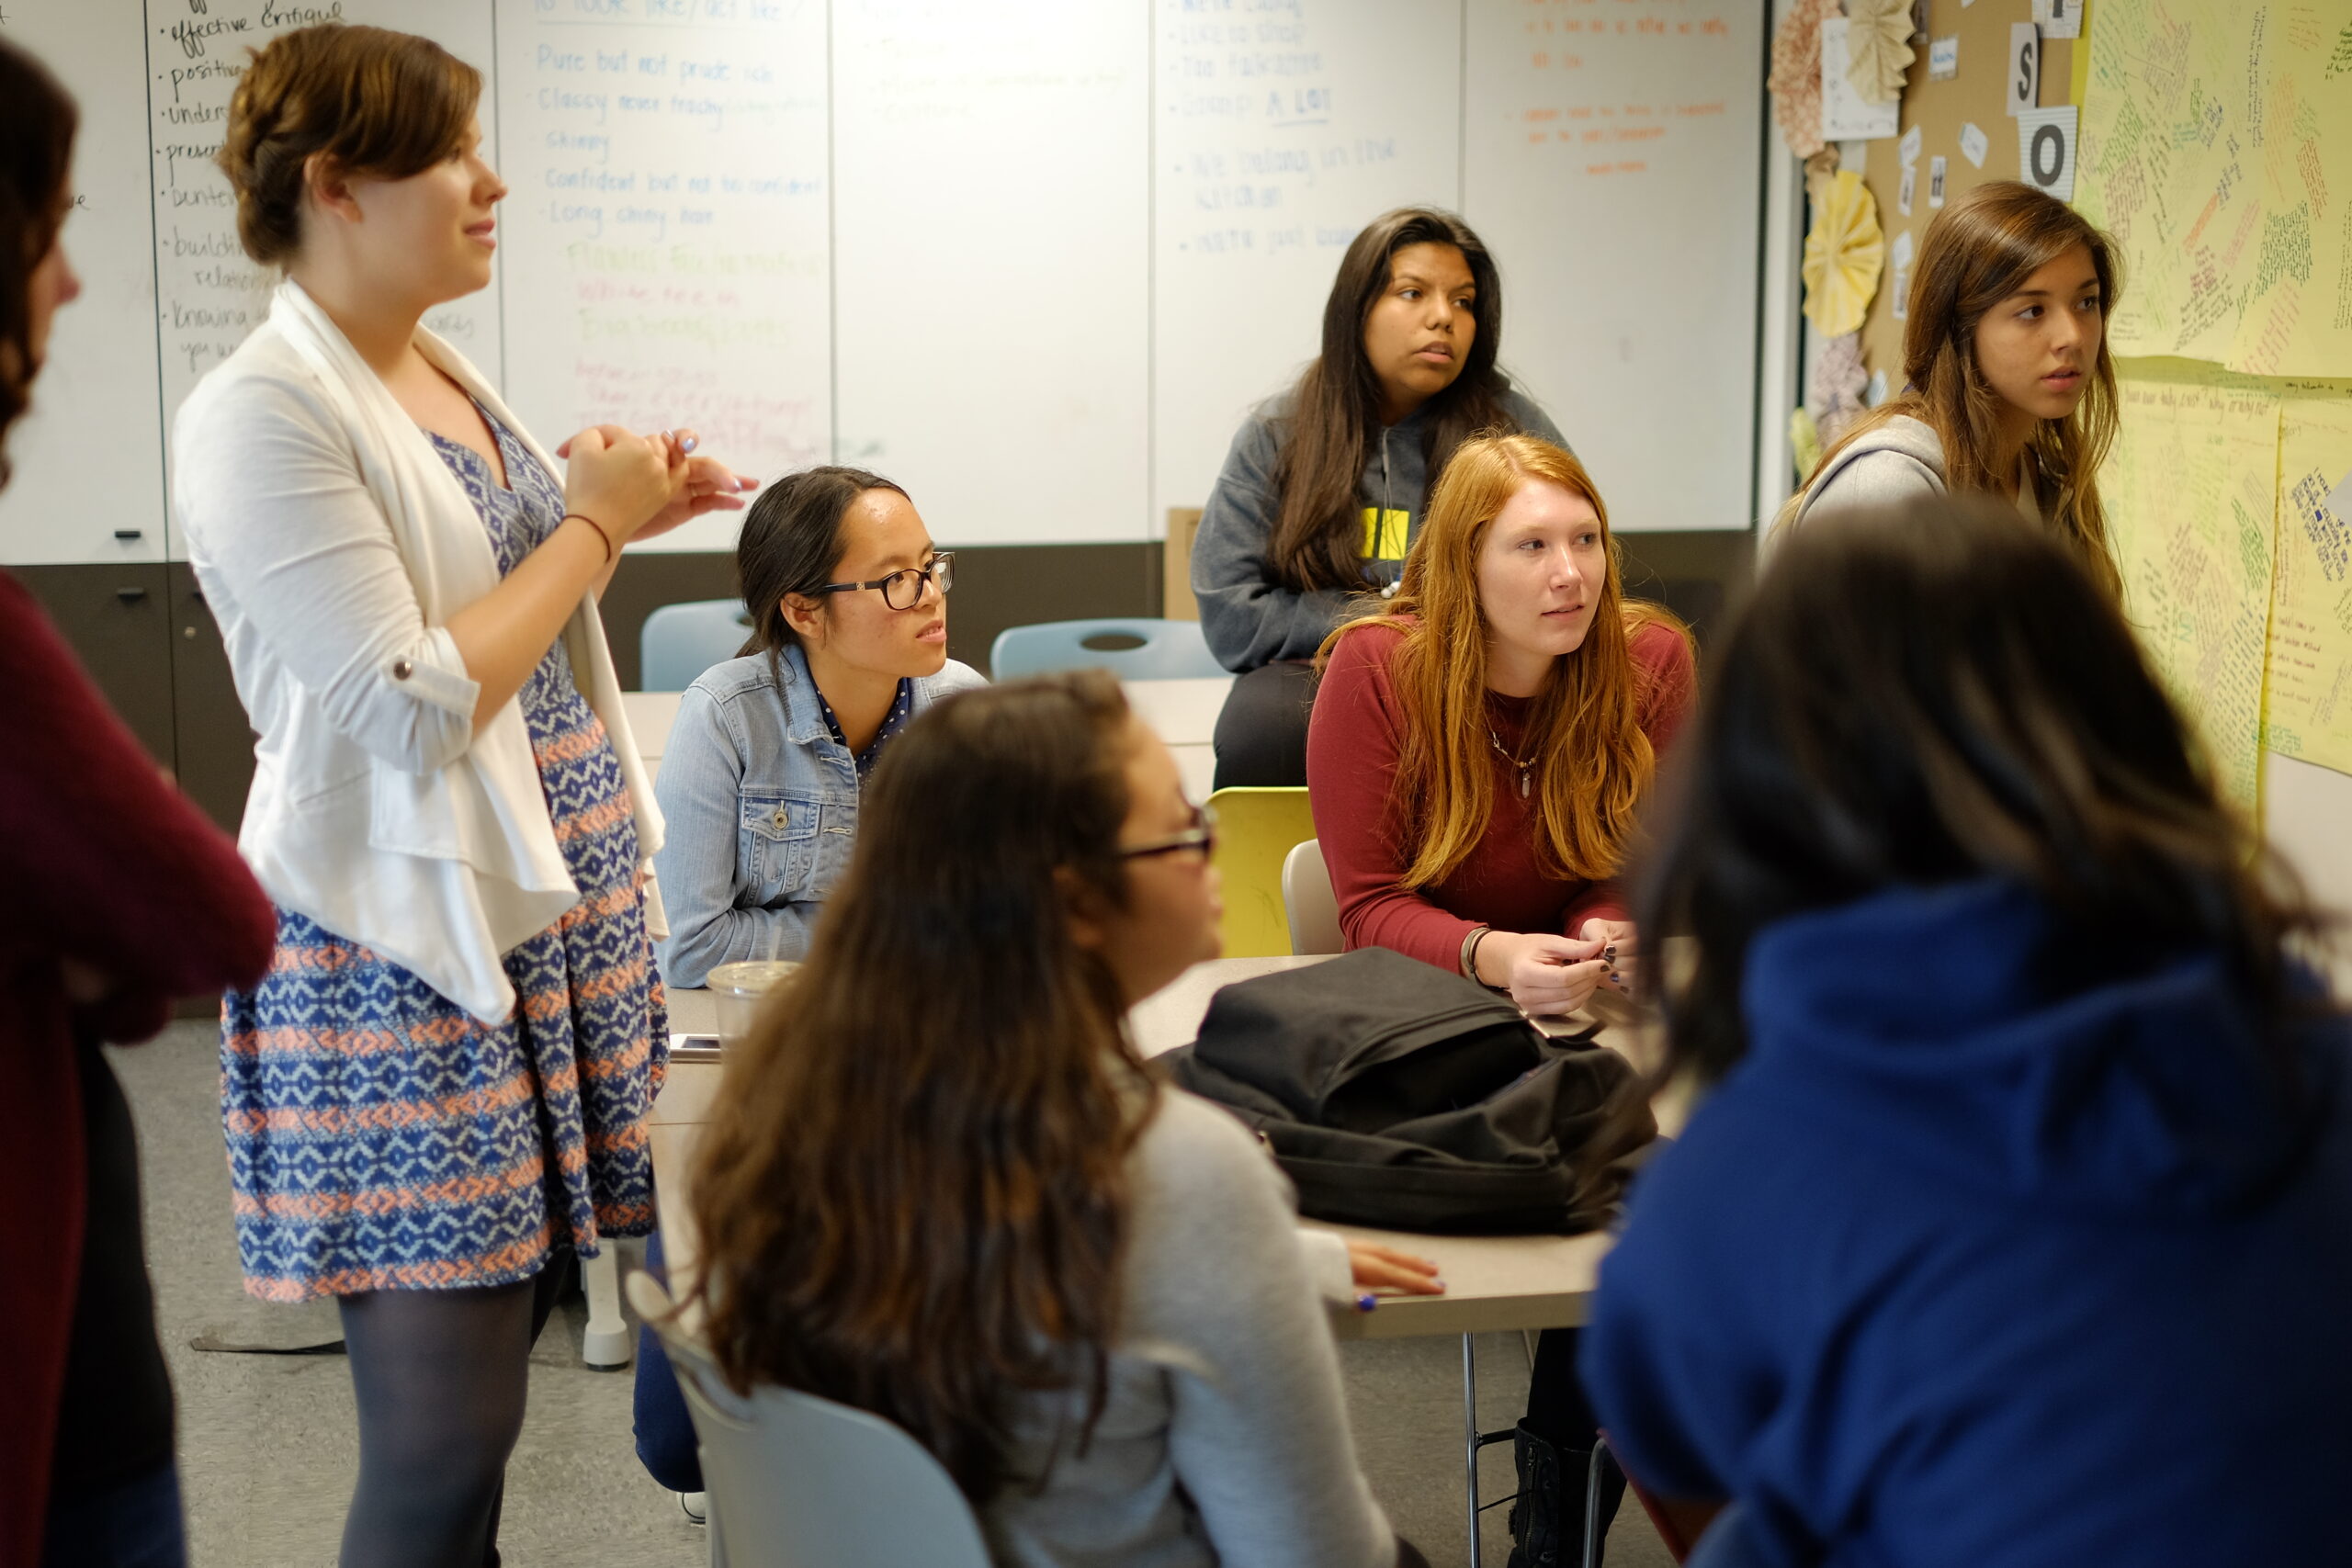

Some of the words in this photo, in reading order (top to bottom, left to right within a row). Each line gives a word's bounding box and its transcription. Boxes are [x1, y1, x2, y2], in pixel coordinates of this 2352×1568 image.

[172, 16, 253, 59] effective
[537, 43, 584, 72] Pure
[597, 50, 628, 73] but
[639, 54, 667, 75] not
[2018, 41, 2032, 101] S
[538, 87, 607, 125] Classy
[1265, 90, 1283, 117] A
[1295, 87, 1331, 114] LOT
[649, 171, 678, 193] but
[550, 202, 603, 238] Long
